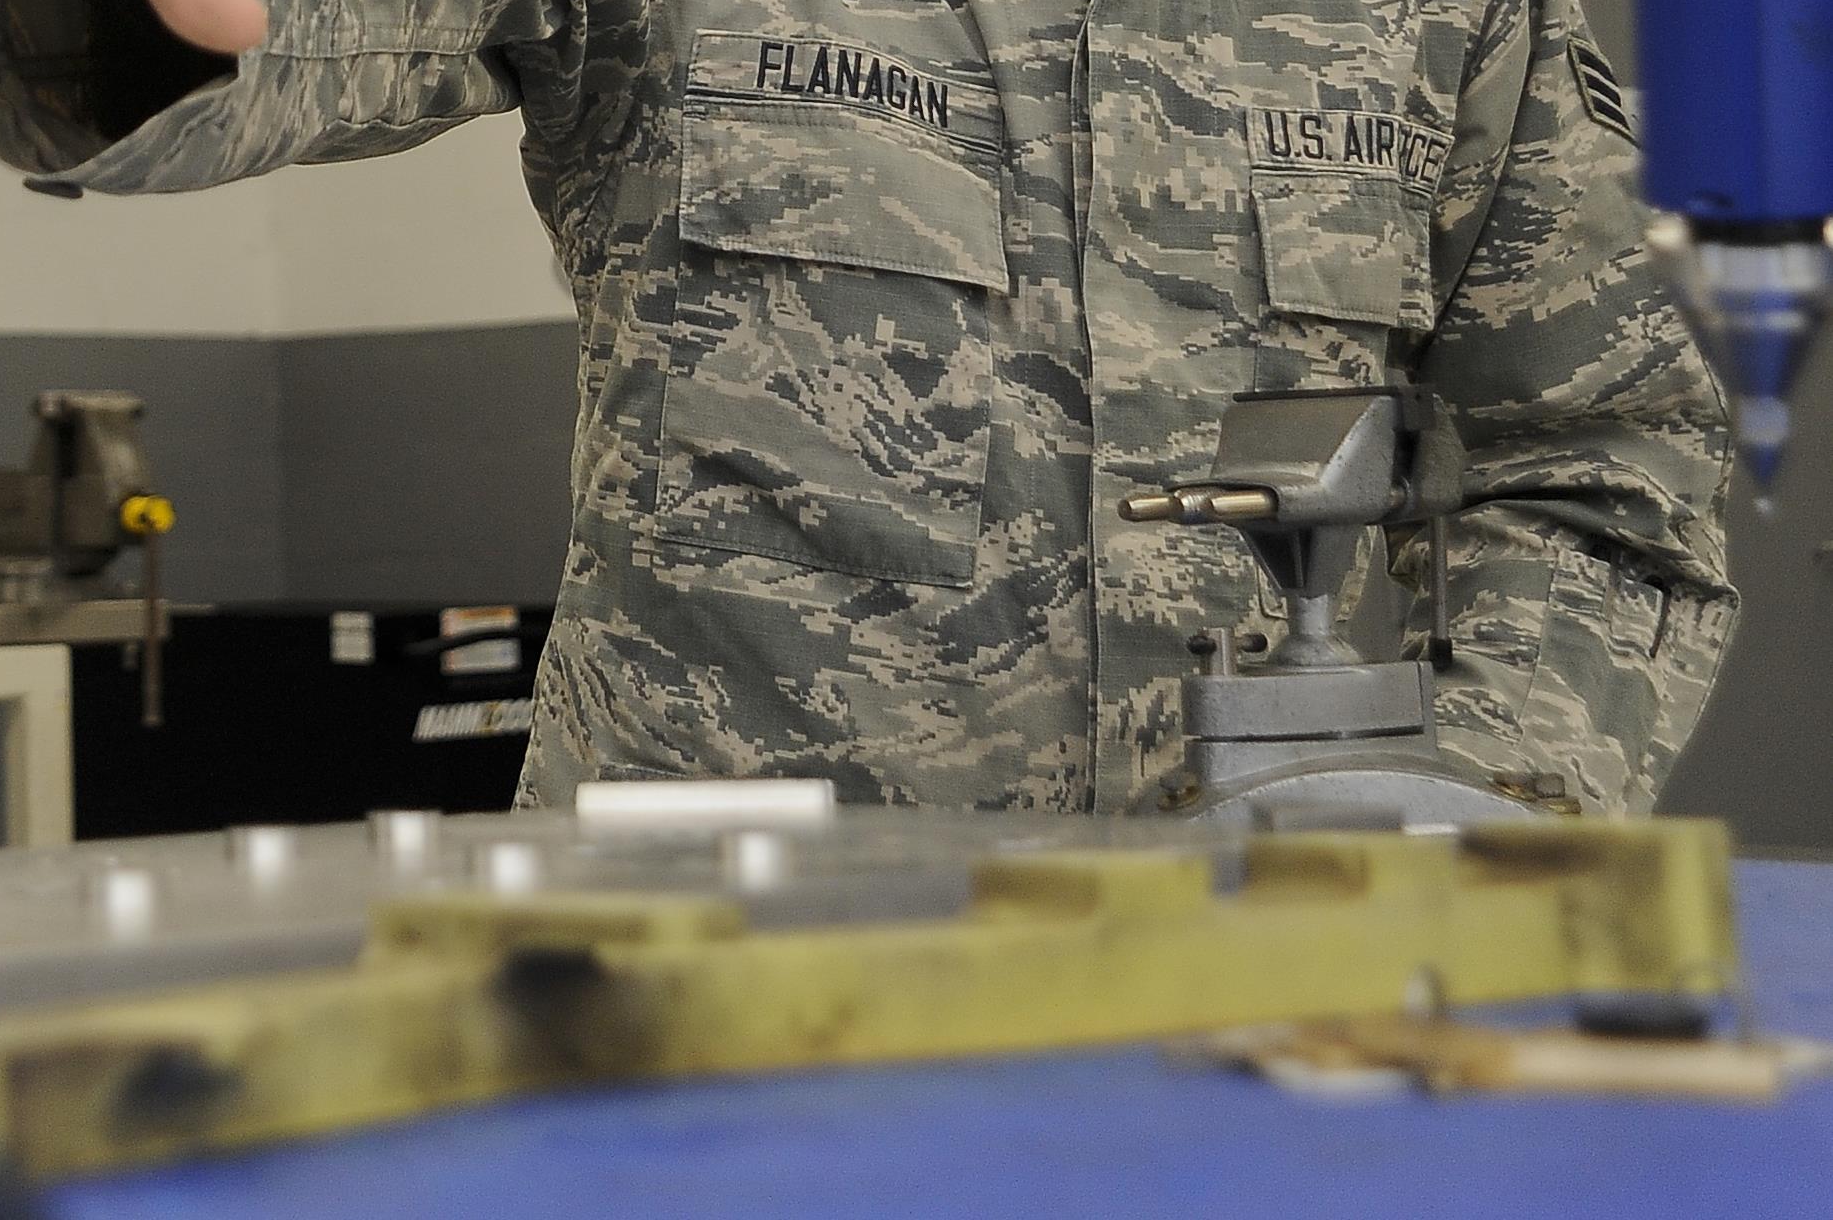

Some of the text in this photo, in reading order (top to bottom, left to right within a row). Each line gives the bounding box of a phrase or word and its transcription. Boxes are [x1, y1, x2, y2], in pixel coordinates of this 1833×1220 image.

[756, 40, 949, 128] FLANAGAN
[1265, 111, 1333, 161] U.S.
[1343, 115, 1394, 166] AIR
